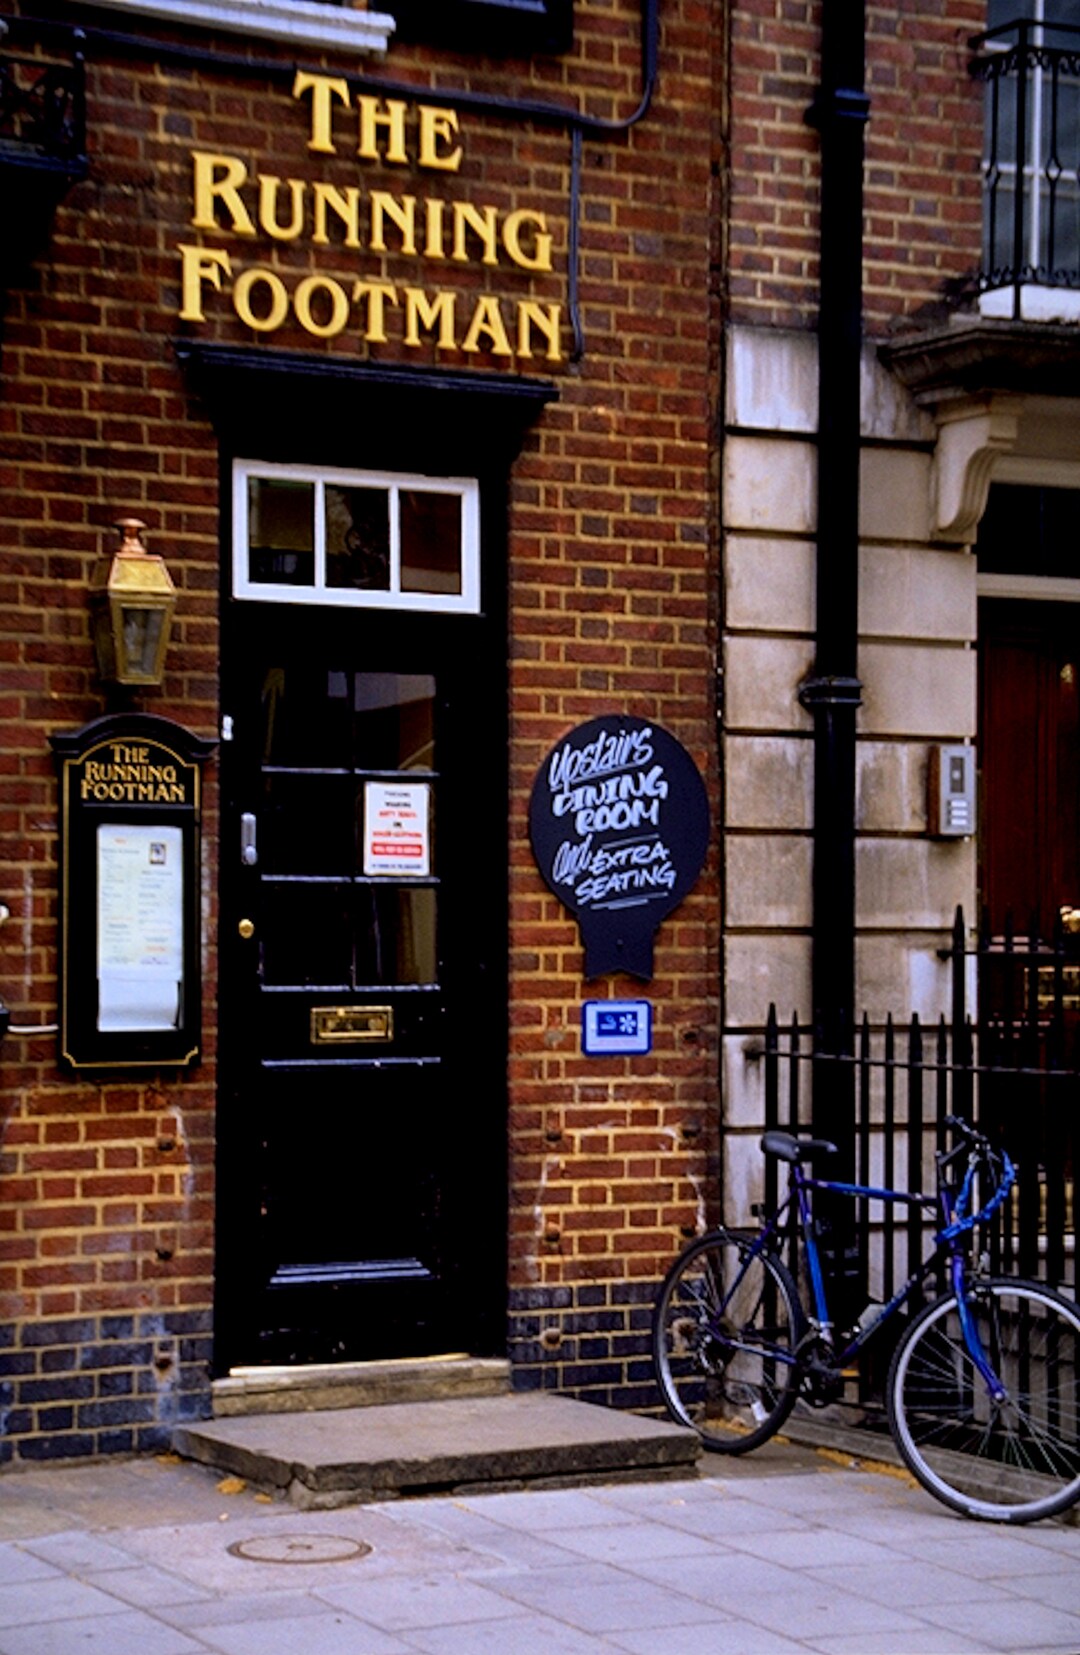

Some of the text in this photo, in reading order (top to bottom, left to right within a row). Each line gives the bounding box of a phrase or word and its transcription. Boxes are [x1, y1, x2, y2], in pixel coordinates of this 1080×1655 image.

[292, 70, 463, 172] THE
[191, 151, 553, 272] RUNNING
[177, 243, 562, 361] FOOTMAN
[85, 761, 177, 783] RUNNING
[110, 743, 149, 764] THE
[549, 727, 653, 793] Upstairs
[80, 779, 185, 802] FOOTMAN
[552, 765, 668, 817] DINING
[575, 799, 660, 835] ROOM
[588, 841, 670, 874] EXTRA
[575, 861, 677, 905] SEATING
